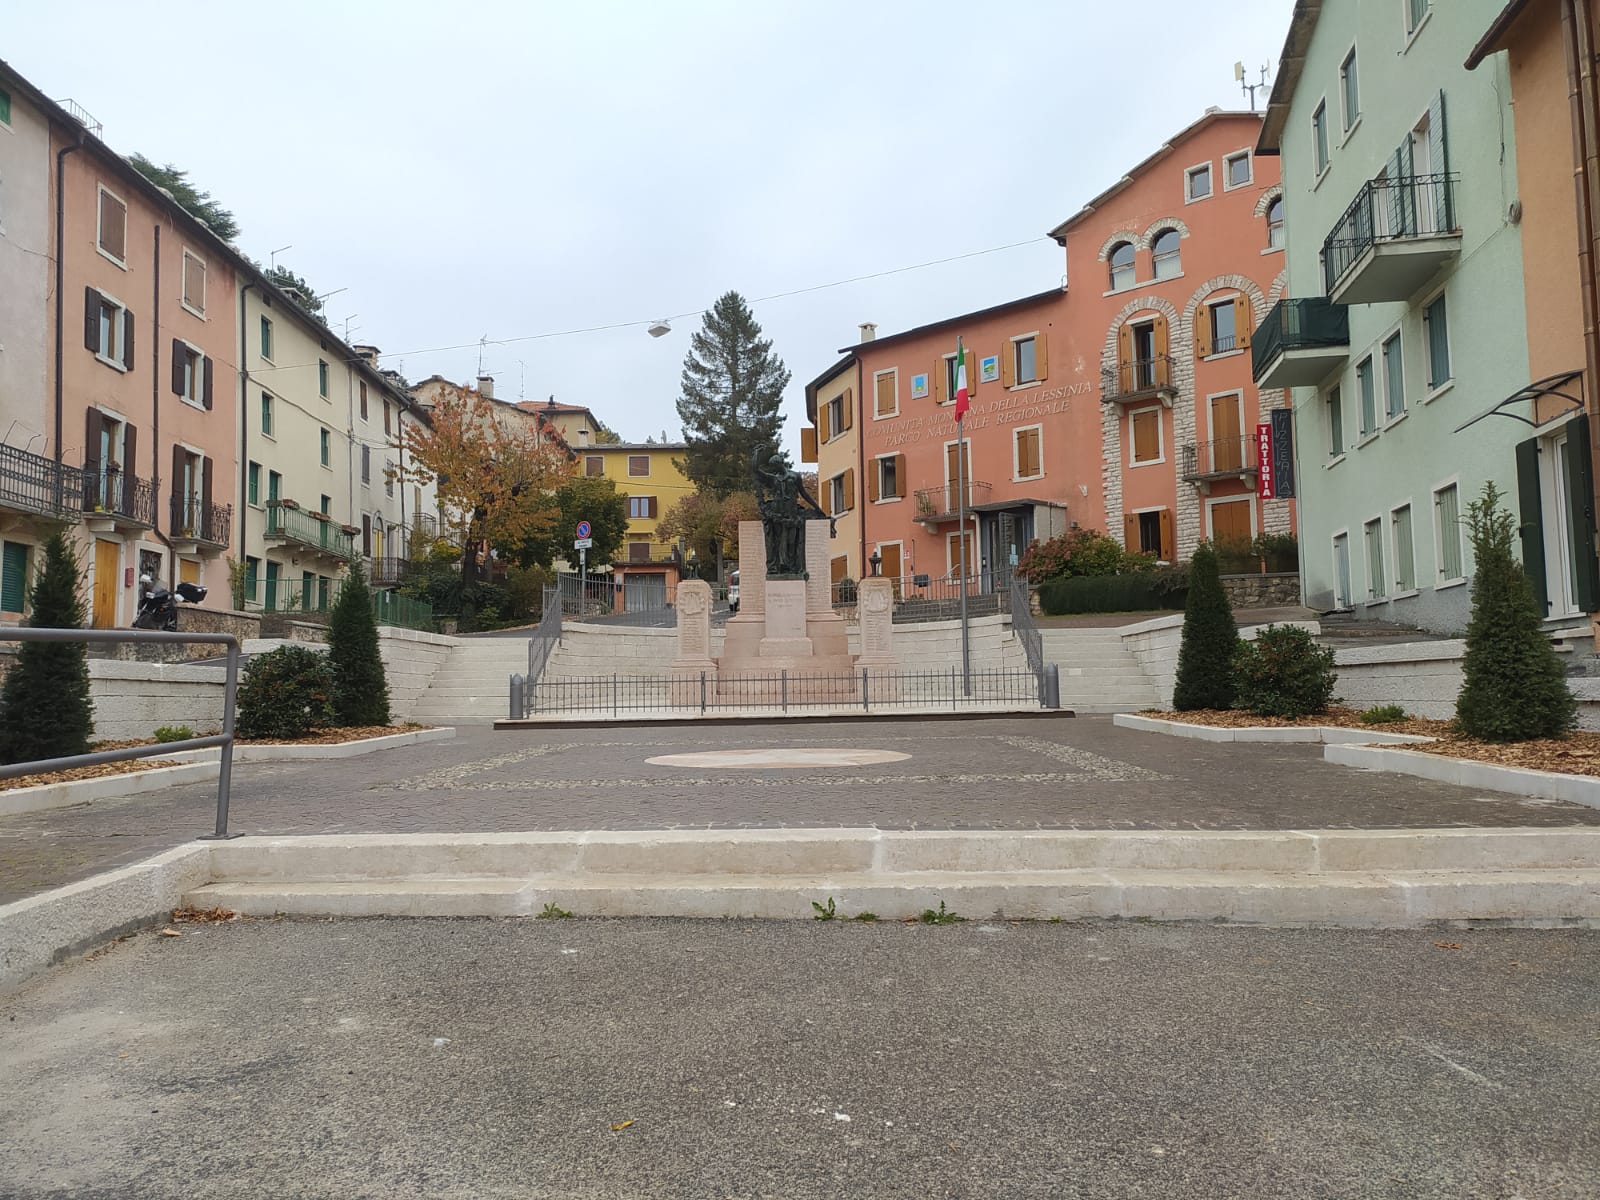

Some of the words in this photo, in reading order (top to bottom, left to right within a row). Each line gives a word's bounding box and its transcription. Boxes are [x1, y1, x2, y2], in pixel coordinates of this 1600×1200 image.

[885, 430, 920, 447] PARCO
[996, 400, 1069, 425] REGIONALE
[989, 394, 1029, 413] DELLA
[1031, 381, 1092, 404] LESSINIA
[1260, 426, 1271, 496] TRATTORIA
[1279, 412, 1290, 489] PIZZERIA
